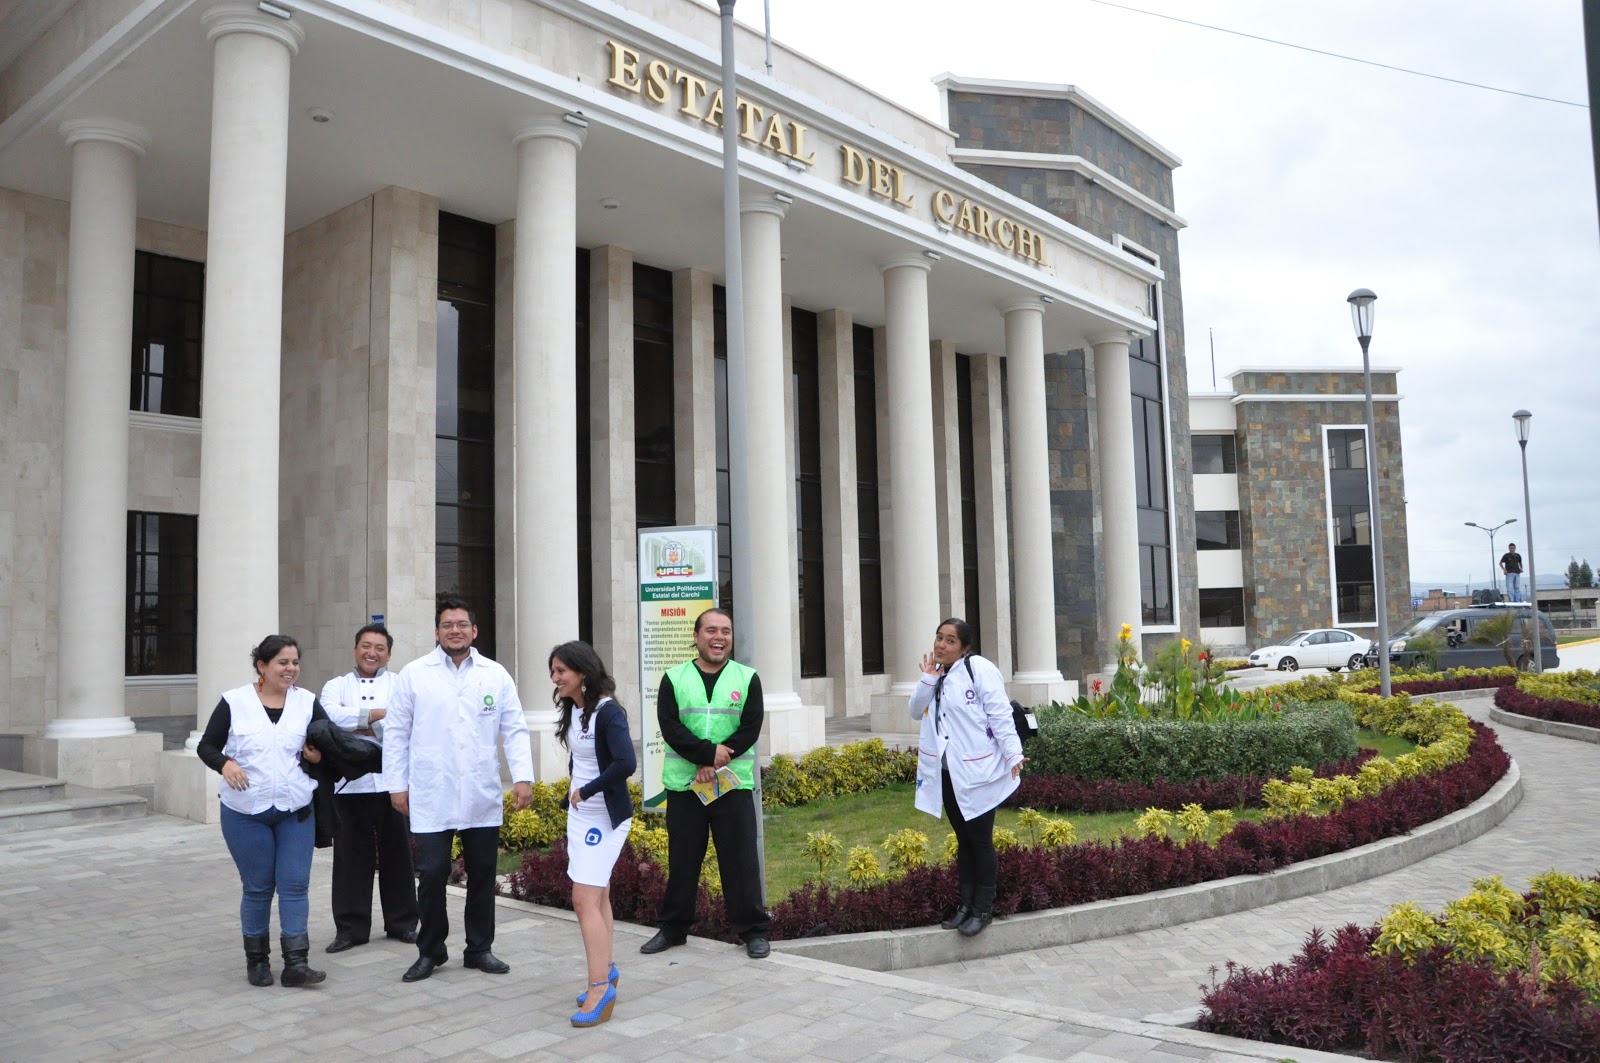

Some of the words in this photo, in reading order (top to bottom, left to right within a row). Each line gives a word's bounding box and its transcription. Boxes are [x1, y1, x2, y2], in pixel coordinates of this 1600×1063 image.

[606, 40, 816, 166] ESTATAL
[840, 144, 915, 208] DEL
[932, 189, 1050, 266] CARCHI
[659, 567, 689, 575] UPEC
[661, 607, 686, 617] MISIÓN
